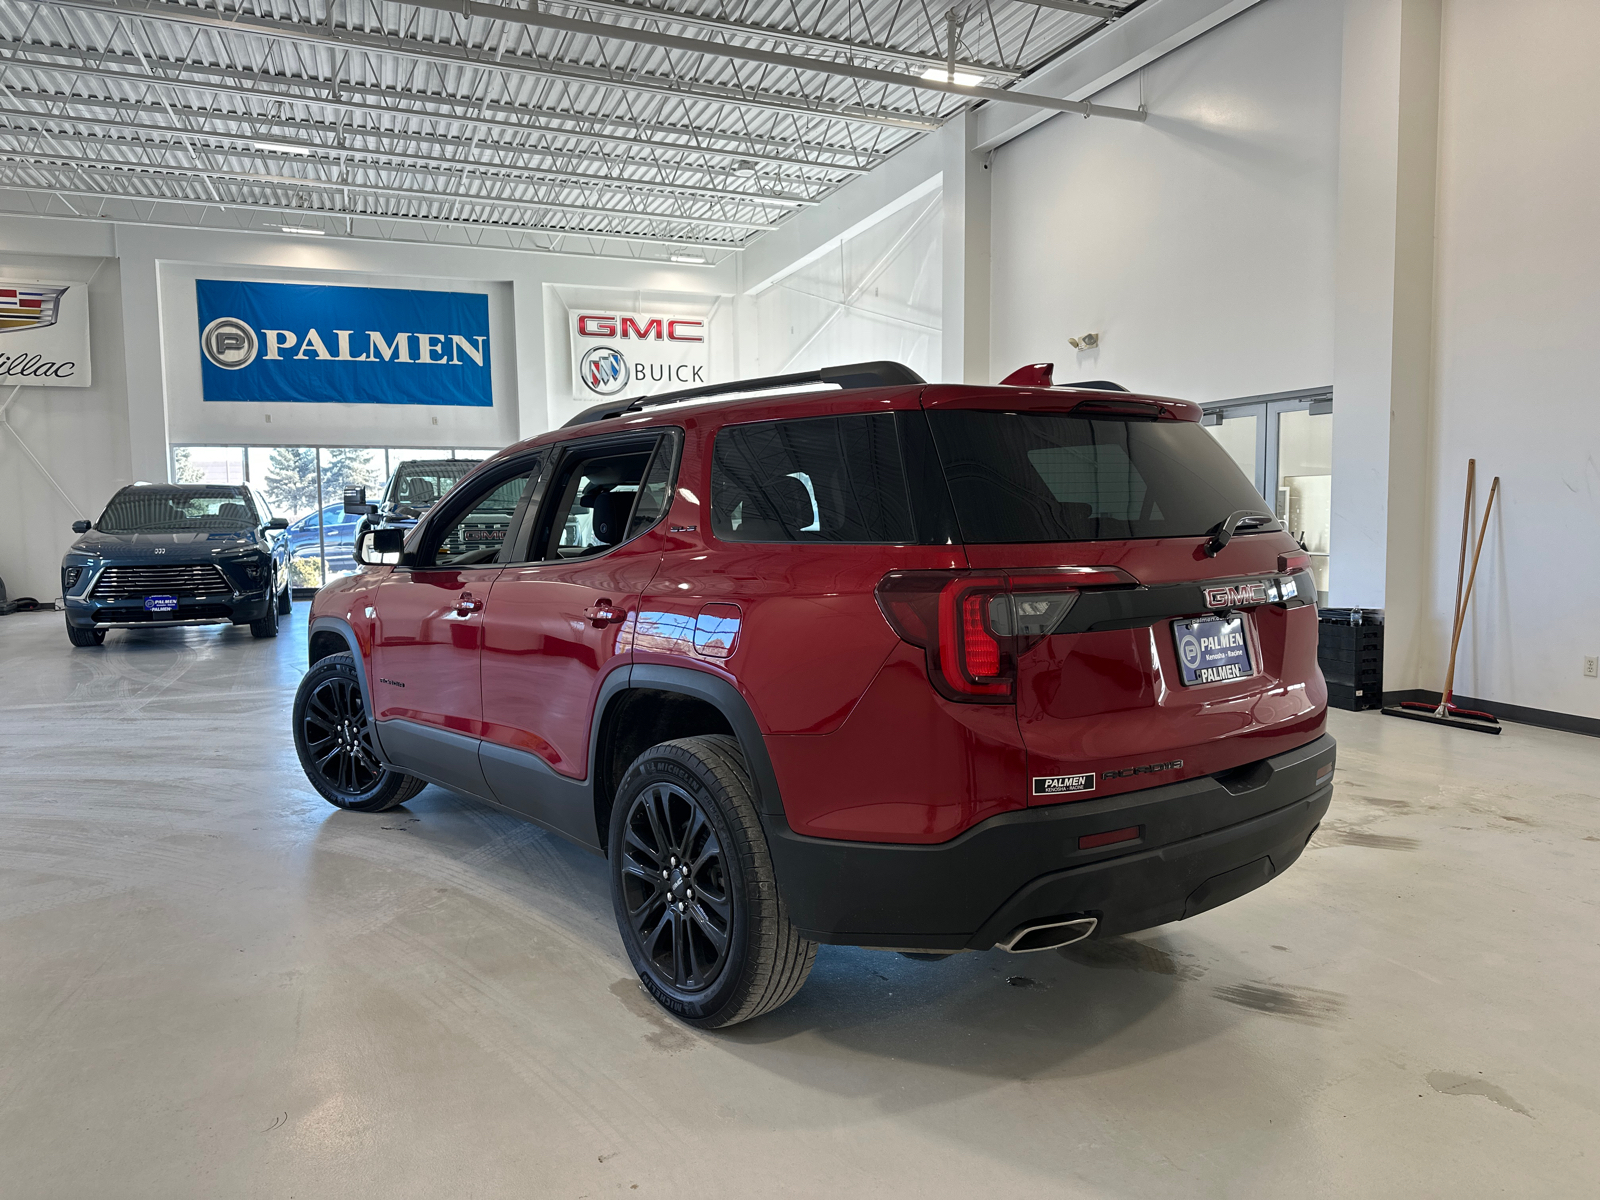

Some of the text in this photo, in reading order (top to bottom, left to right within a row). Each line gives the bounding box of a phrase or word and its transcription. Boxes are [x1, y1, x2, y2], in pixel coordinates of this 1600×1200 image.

[577, 313, 705, 343] GMC
[260, 328, 487, 367] PALMEN
[0, 352, 75, 378] illac
[635, 363, 705, 383] BUICK
[1203, 583, 1267, 609] GMC
[1192, 616, 1230, 624] palmen.c
[1200, 632, 1244, 651] PALMEN
[1206, 652, 1225, 661] Kenosha
[1228, 650, 1243, 658] Racine
[1201, 664, 1240, 683] PALMEN
[657, 762, 700, 791] MICHELIN
[1101, 759, 1184, 780] ACADIA
[1044, 776, 1086, 788] PALMEN
[642, 974, 682, 1012] MICHELIN
